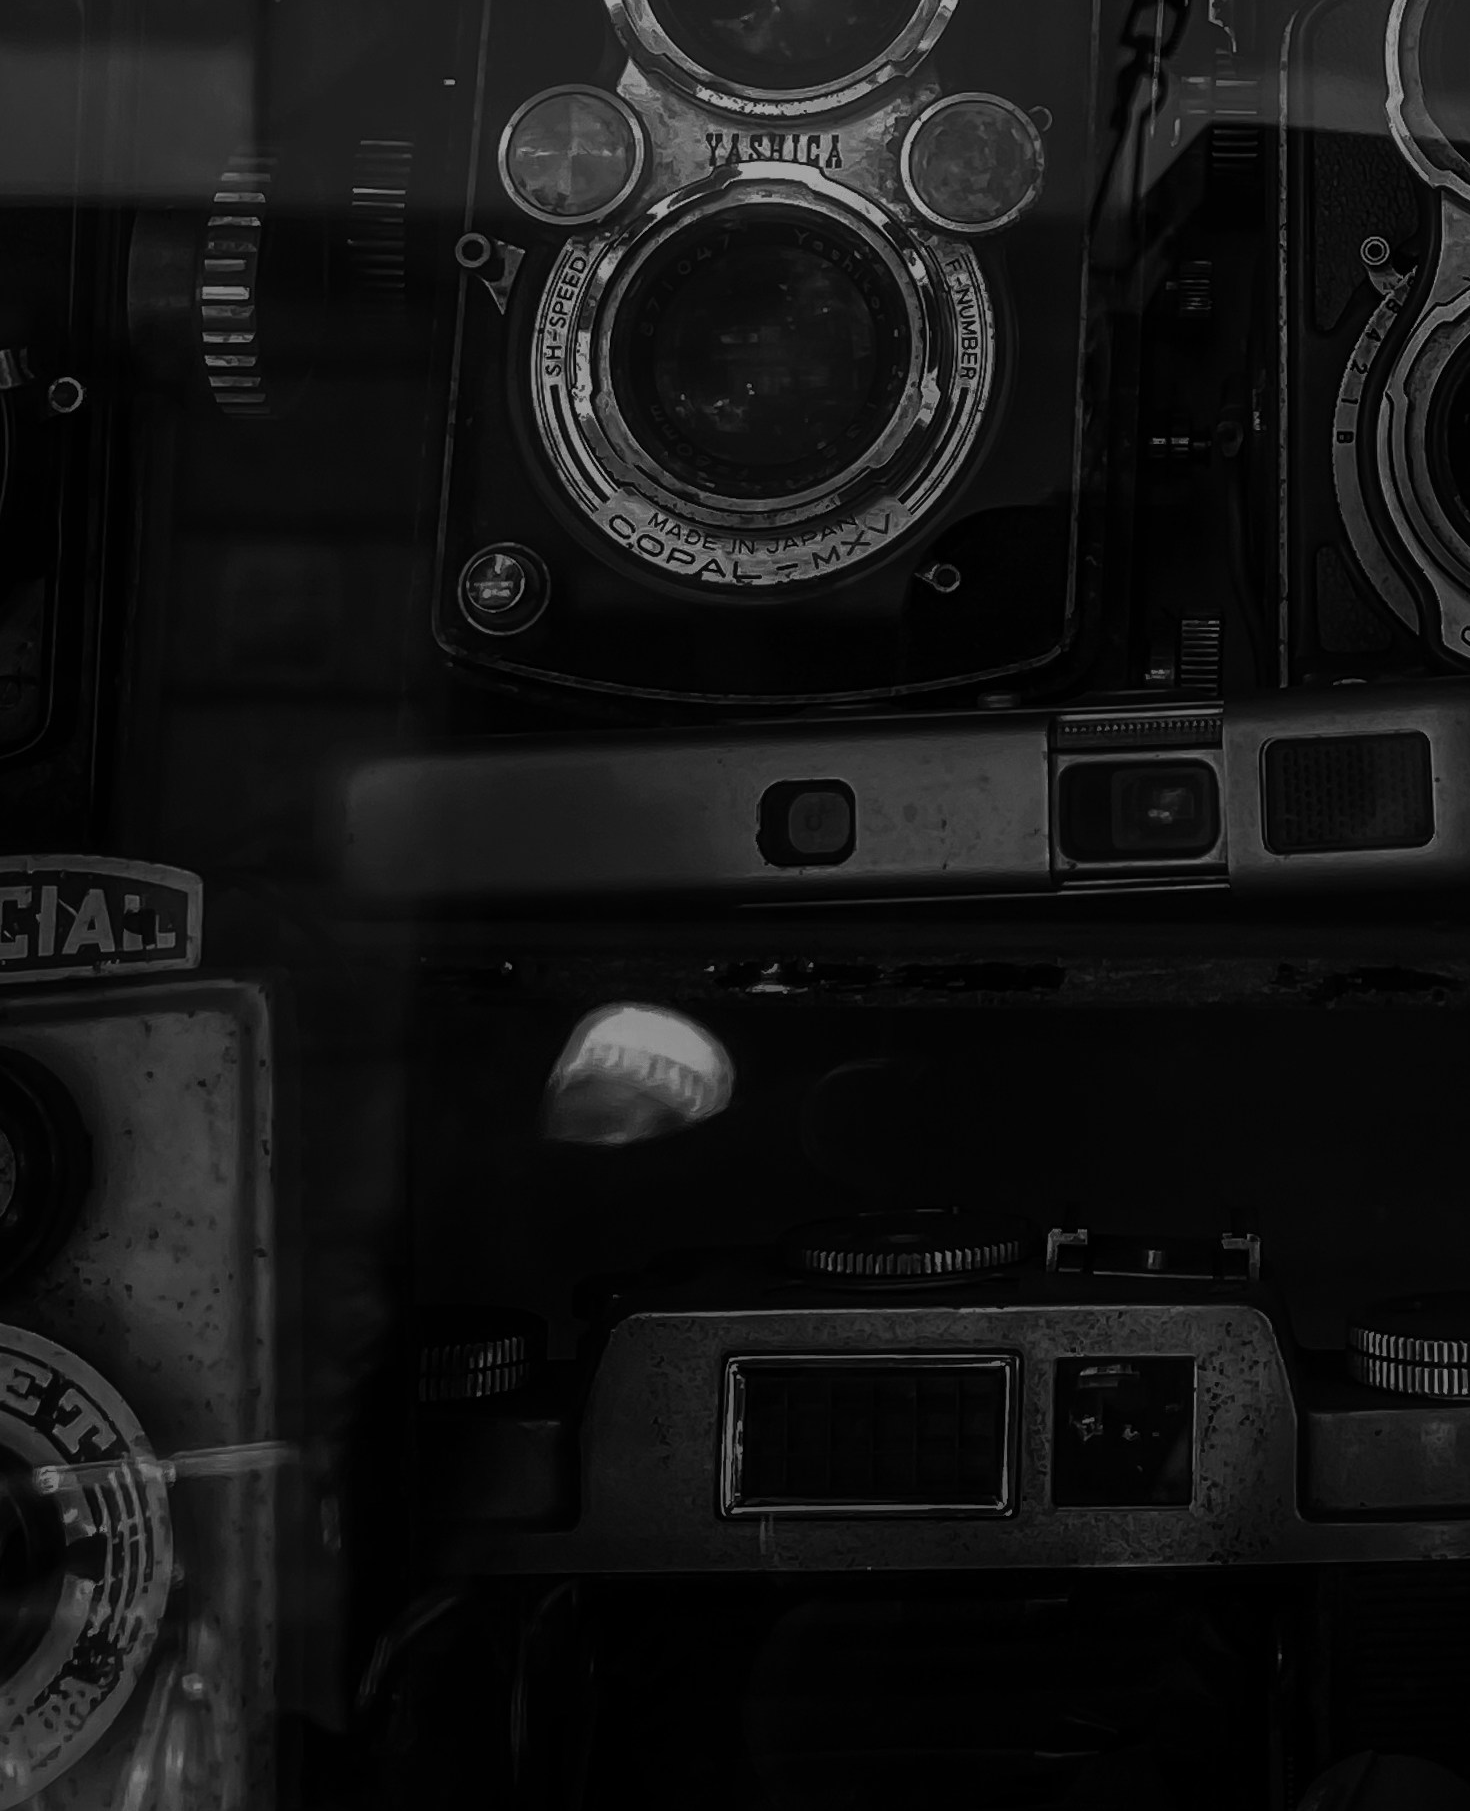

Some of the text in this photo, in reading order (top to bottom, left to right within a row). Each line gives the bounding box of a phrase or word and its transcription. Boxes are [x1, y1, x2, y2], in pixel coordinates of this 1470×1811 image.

[705, 132, 842, 168] YASHICA
[545, 256, 588, 377] SH-SPEED
[793, 226, 887, 322] Yashikor
[945, 258, 979, 381] F-NUMBER
[648, 512, 859, 556] MADE IN JAPAN
[0, 885, 177, 958] CIAL
[0, 1352, 118, 1455] ET
